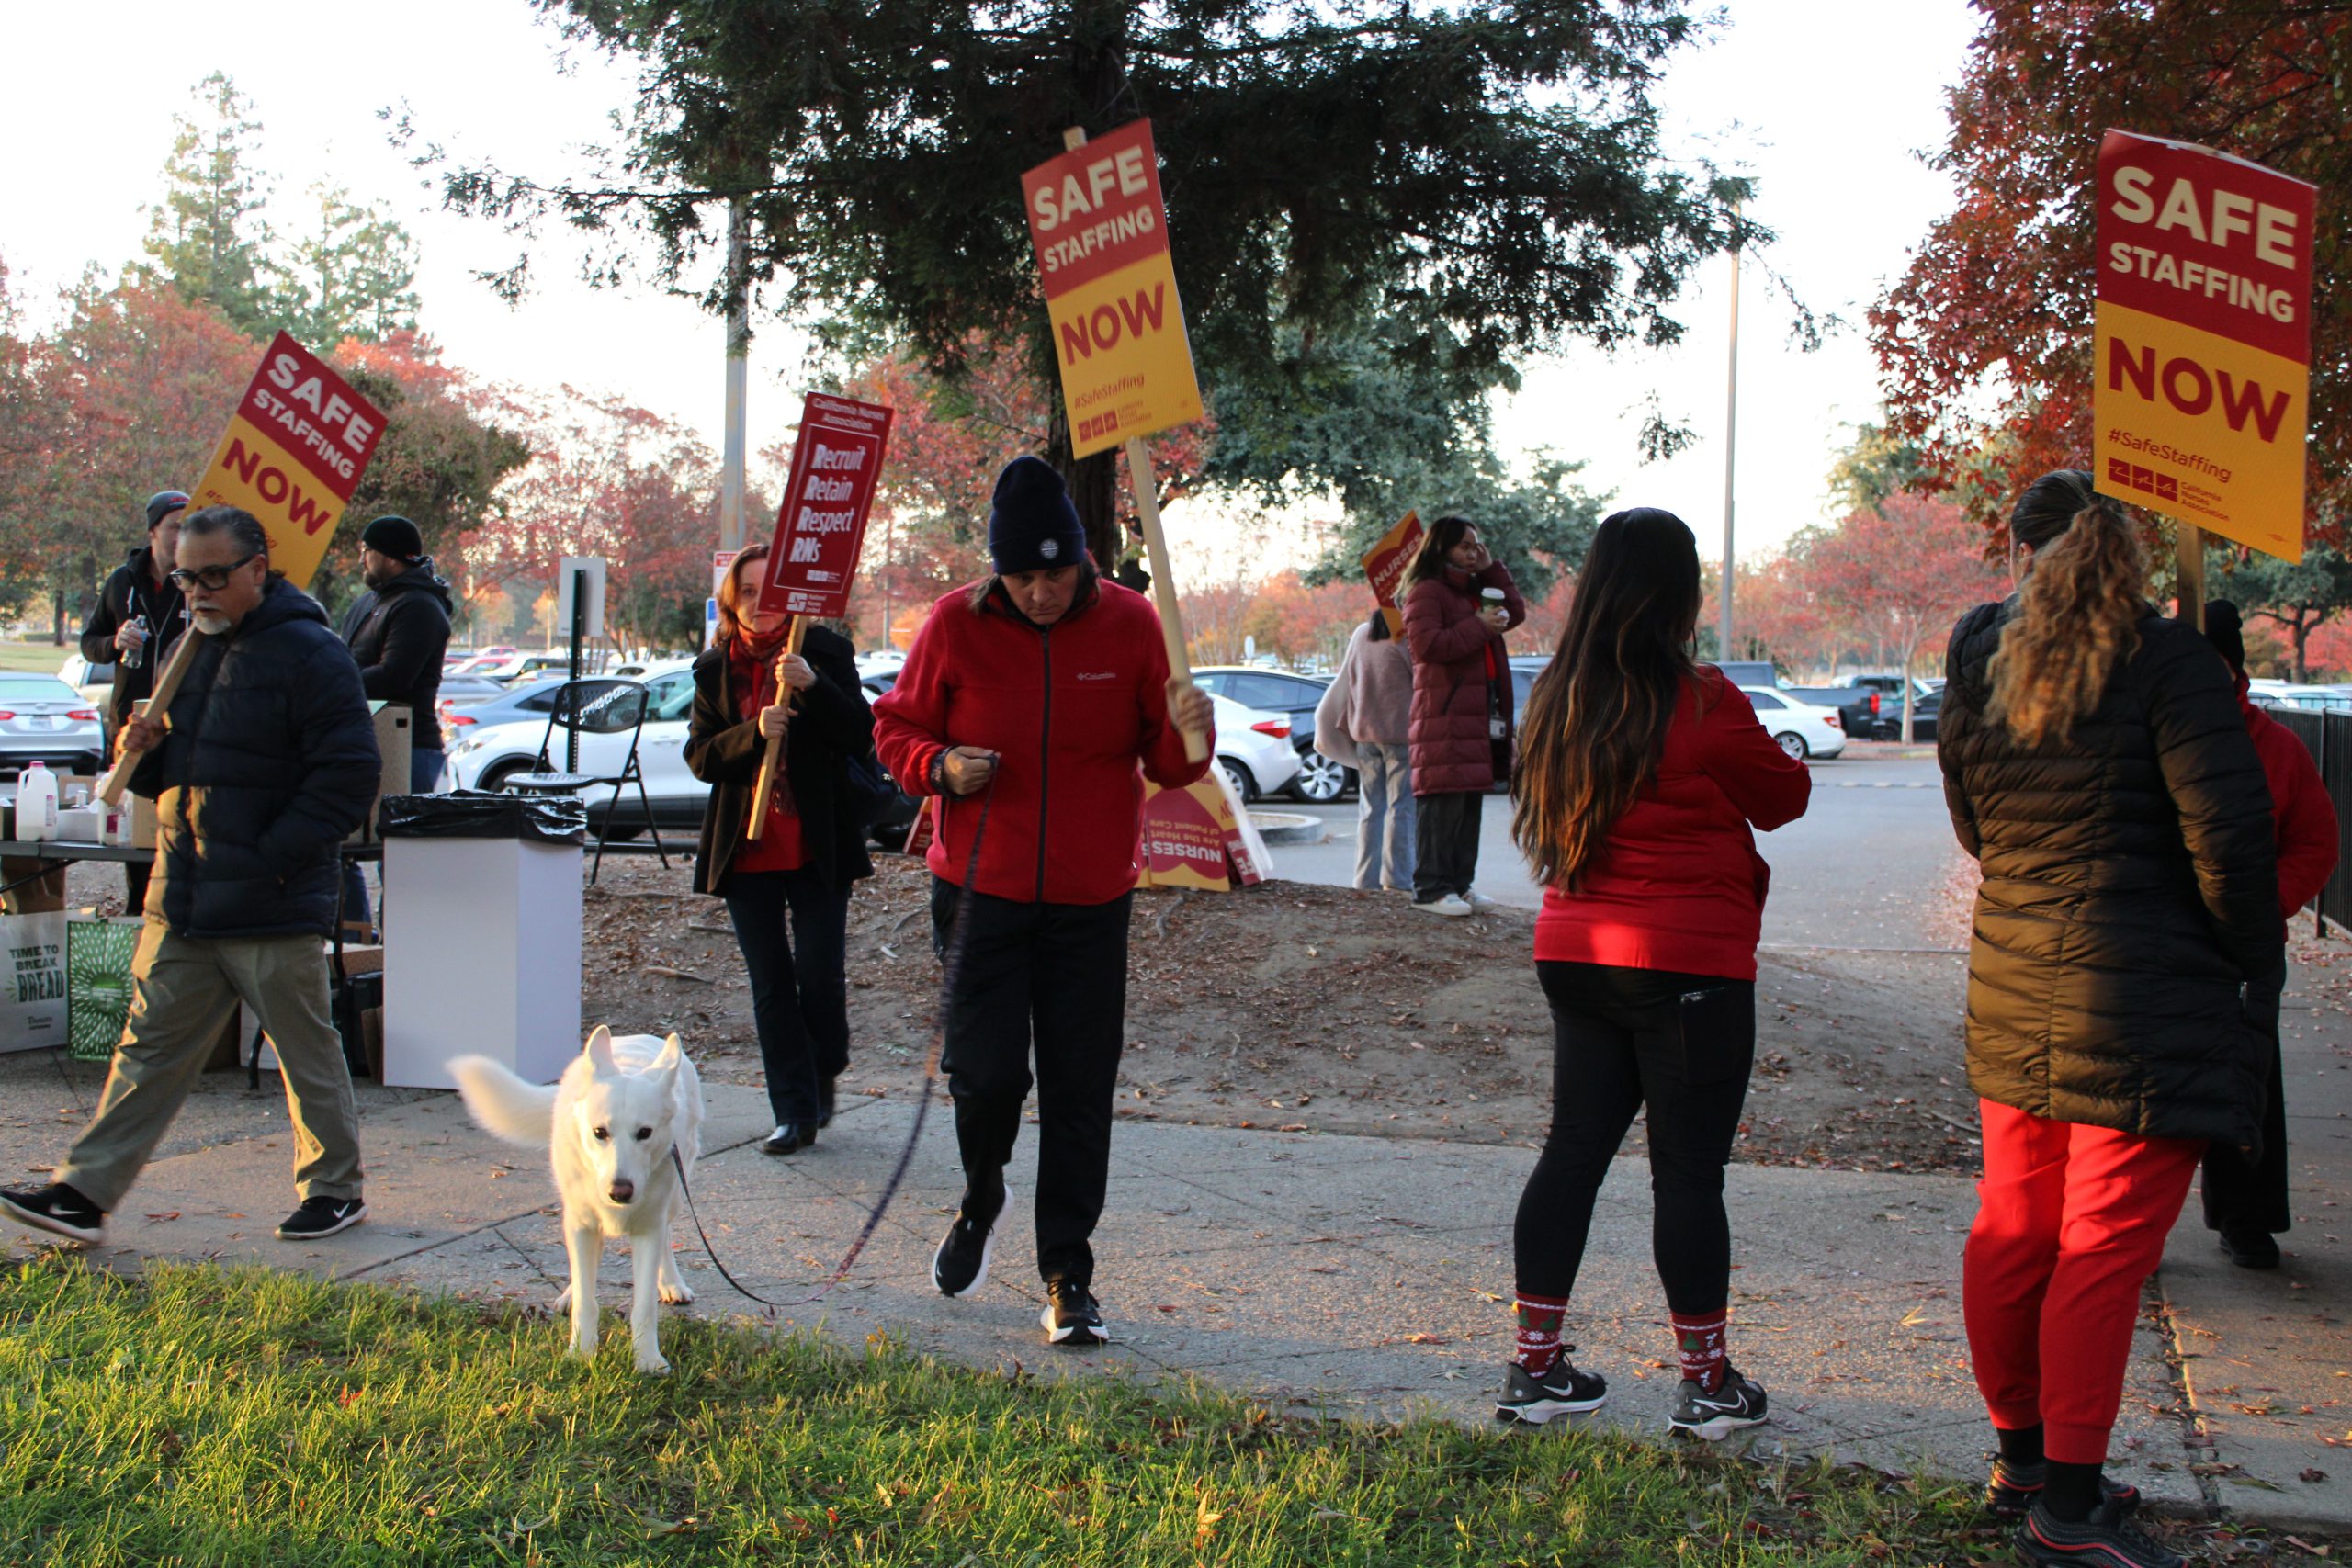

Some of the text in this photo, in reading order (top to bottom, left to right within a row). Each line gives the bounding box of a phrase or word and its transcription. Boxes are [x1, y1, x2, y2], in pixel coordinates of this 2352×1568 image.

[1034, 145, 1148, 231] SAFE
[1044, 204, 1156, 273] STAFFING
[2111, 166, 2298, 270] SAFE
[2109, 242, 2295, 323] STAFFING
[1060, 280, 1164, 367] NOW
[266, 354, 374, 454] SAFE
[1074, 373, 1146, 411] #SafeStaffing
[2109, 336, 2291, 444] NOW
[253, 389, 355, 479] STAFFING
[811, 443, 866, 470] Recruit
[2109, 428, 2233, 484] #SafeStaffing
[221, 437, 332, 536] NOW
[802, 475, 854, 501] Retain
[796, 506, 855, 536] Respect
[788, 537, 822, 563] RNs
[1373, 533, 1423, 587] NURSES
[1150, 829, 1182, 840] Heart
[1151, 840, 1223, 863] NURSES
[9, 944, 60, 958] TIME TO
[15, 957, 59, 971] BREAK
[17, 970, 65, 1002] BREAD
